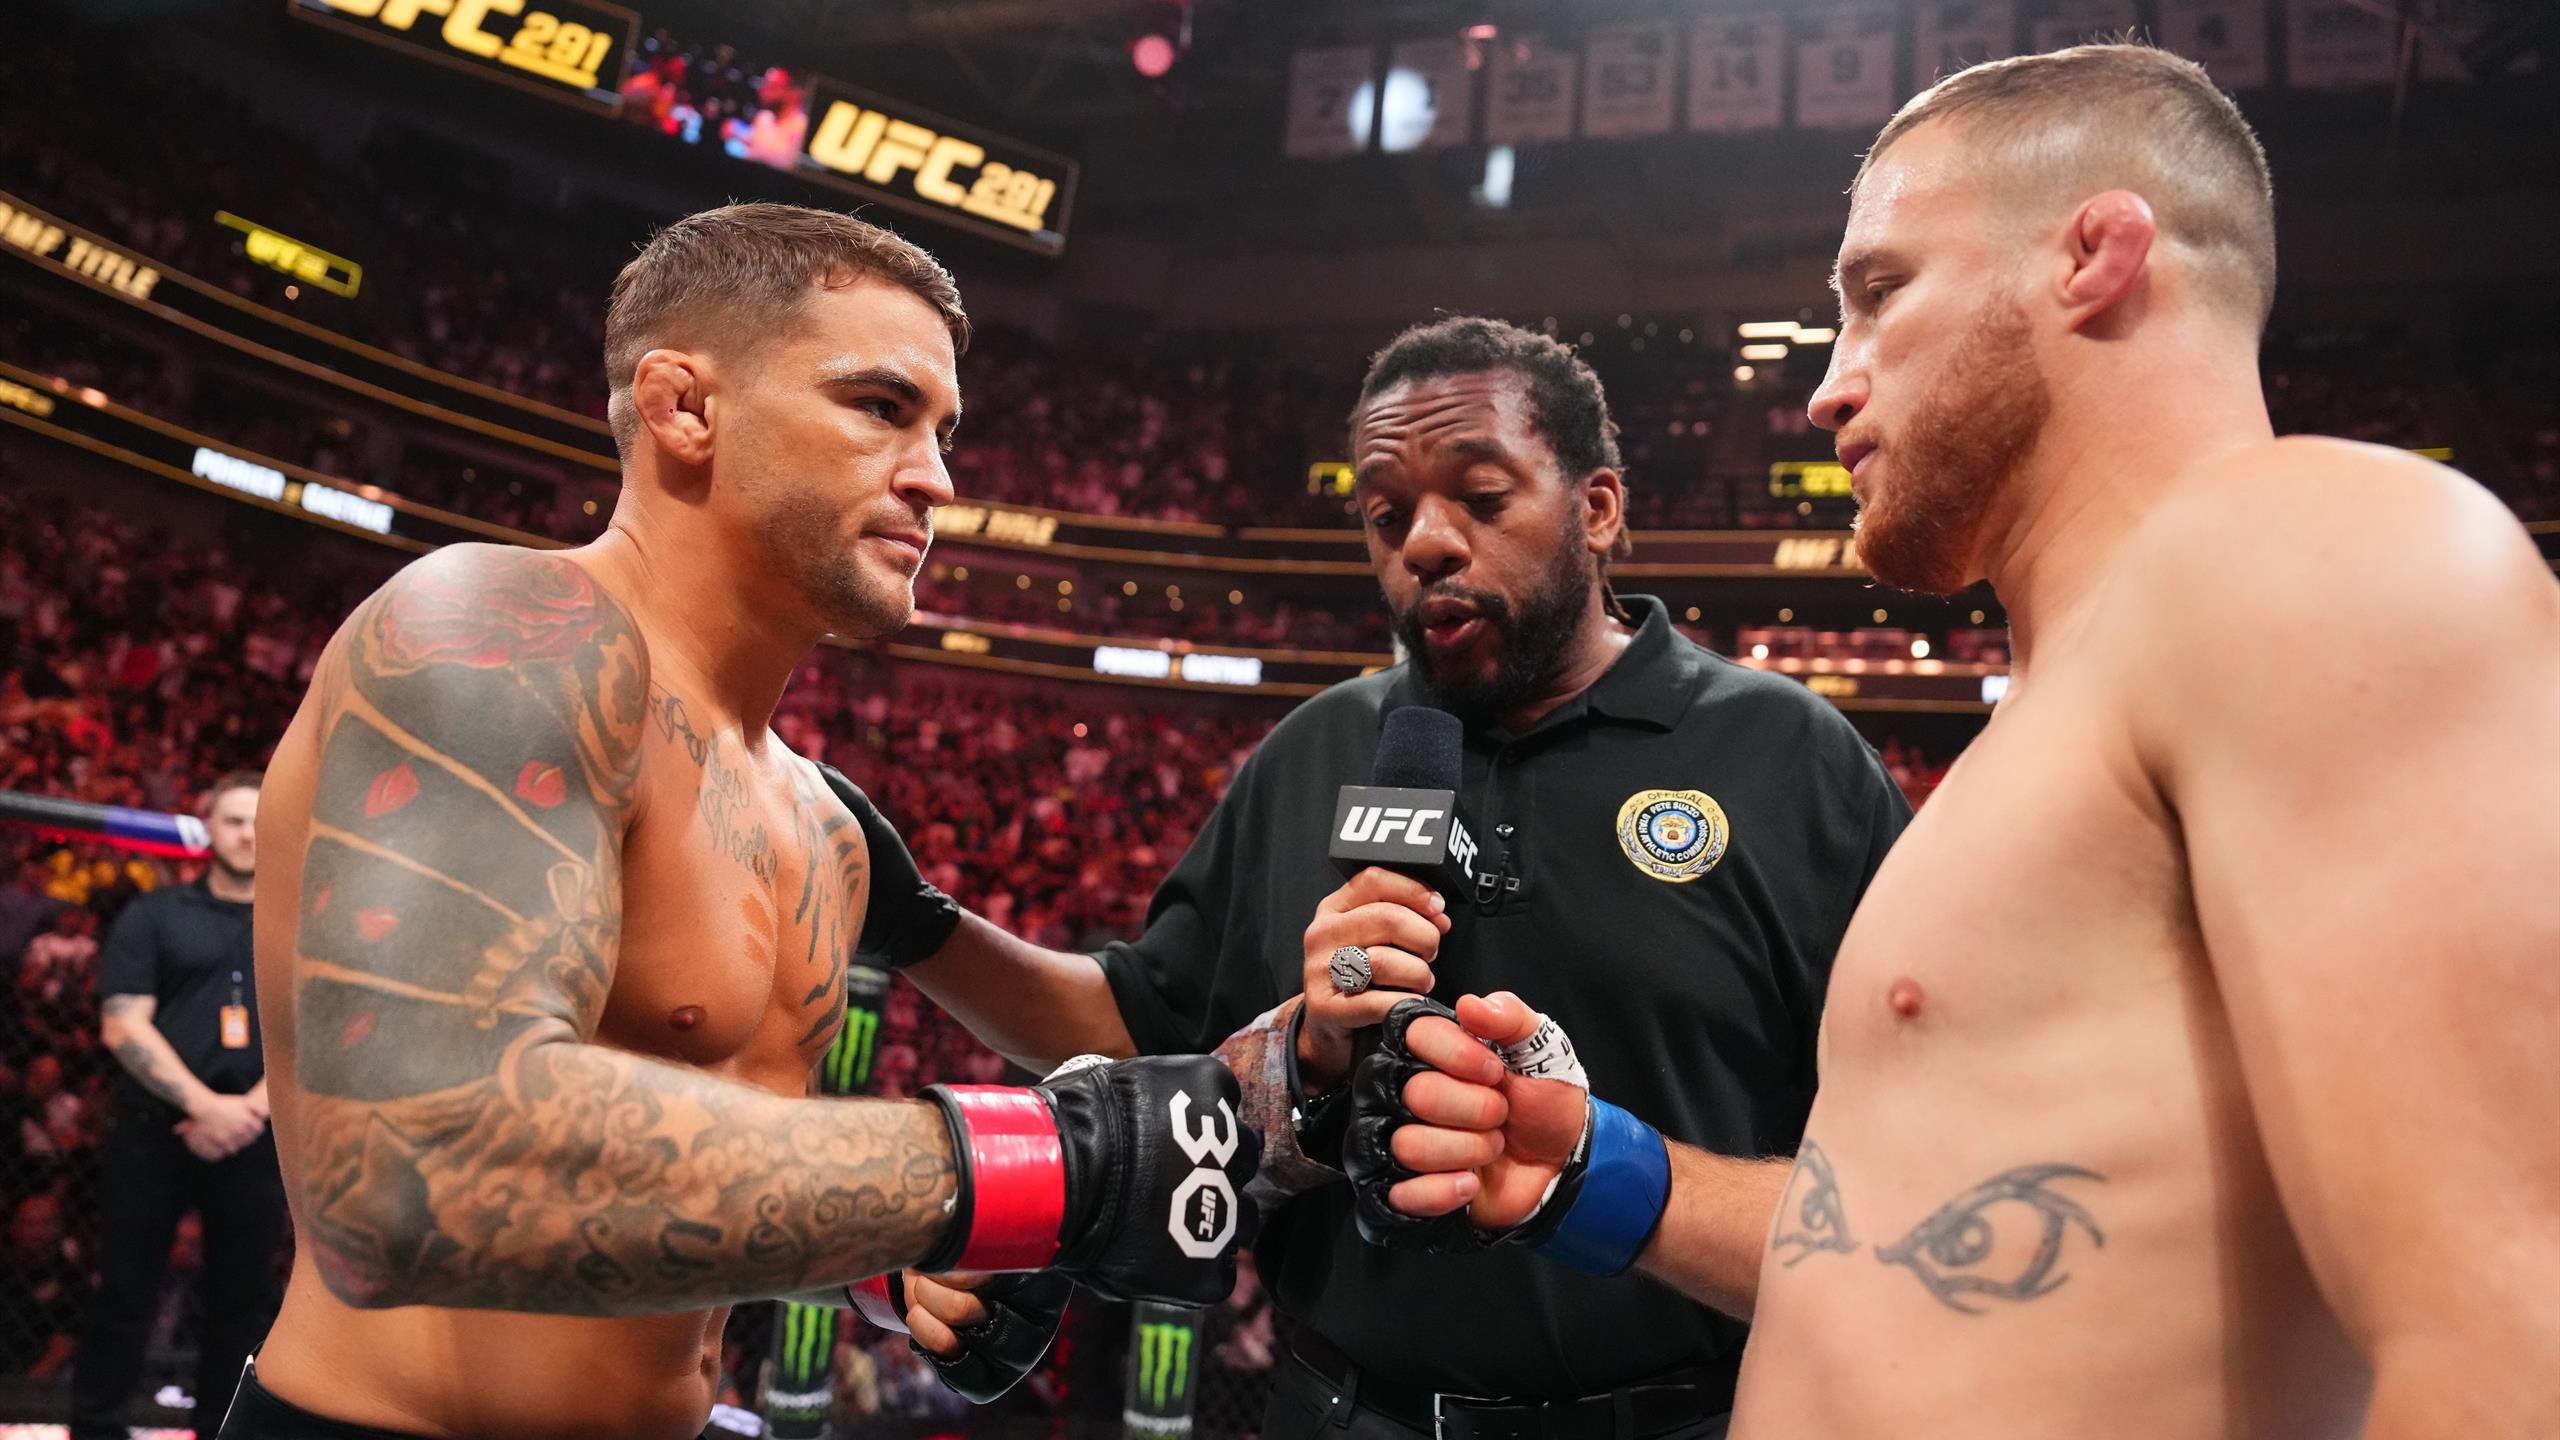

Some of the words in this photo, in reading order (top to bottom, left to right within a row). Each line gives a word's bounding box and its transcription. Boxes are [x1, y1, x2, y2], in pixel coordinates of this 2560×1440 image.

[511, 11, 613, 73] 291
[809, 100, 985, 206] UFC
[970, 162, 1056, 216] 291
[1647, 792, 1704, 807] OFFICIAL
[1649, 802, 1672, 814] PETE
[1673, 802, 1700, 818] SUAZO
[1339, 806, 1444, 845] UFC
[1448, 816, 1479, 880] UFC
[1639, 834, 1676, 861] ATHLETIC
[1676, 819, 1709, 861] COMMISSION
[1529, 1022, 1555, 1052] UFC
[1168, 1089, 1239, 1258] 30
[1198, 1187, 1217, 1239] UFC
